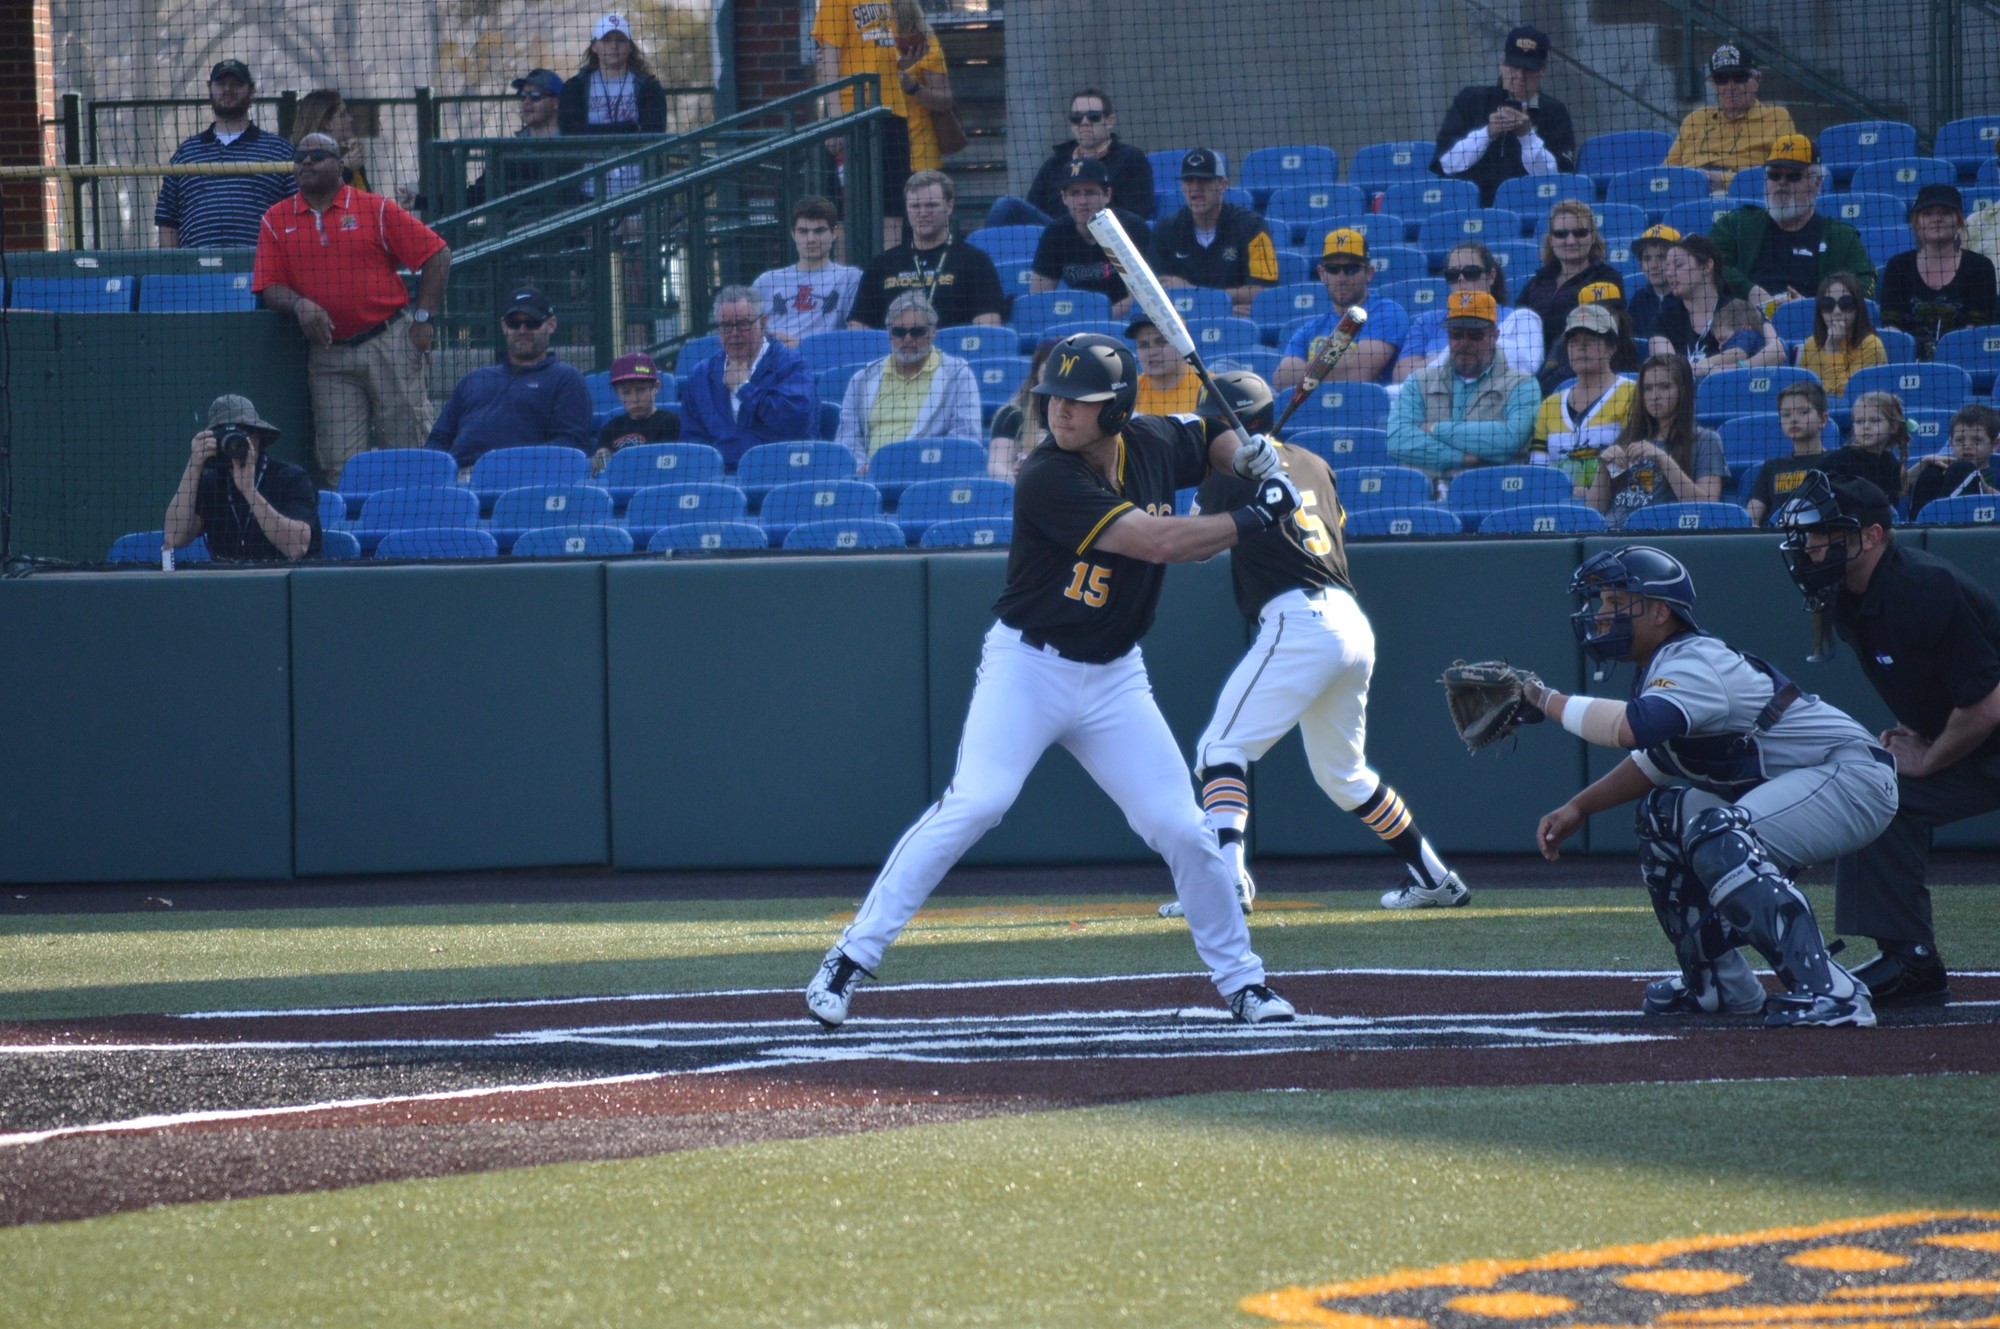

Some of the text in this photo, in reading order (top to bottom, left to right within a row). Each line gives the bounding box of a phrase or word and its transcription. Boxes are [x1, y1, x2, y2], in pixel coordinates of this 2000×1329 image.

[1337, 235, 1348, 248] W
[1592, 286, 1605, 300] W
[1460, 293, 1472, 308] W
[1059, 354, 1080, 376] W
[1753, 381, 1766, 389] 10
[1904, 377, 1916, 387] 11
[1923, 425, 1936, 433] 12
[1506, 480, 1519, 489] 10
[1978, 510, 1992, 519] 14
[1293, 490, 1331, 556] 5
[1538, 520, 1550, 530] 11
[1683, 517, 1697, 526] 12
[1394, 522, 1408, 532] 10
[1063, 561, 1112, 608] 15
